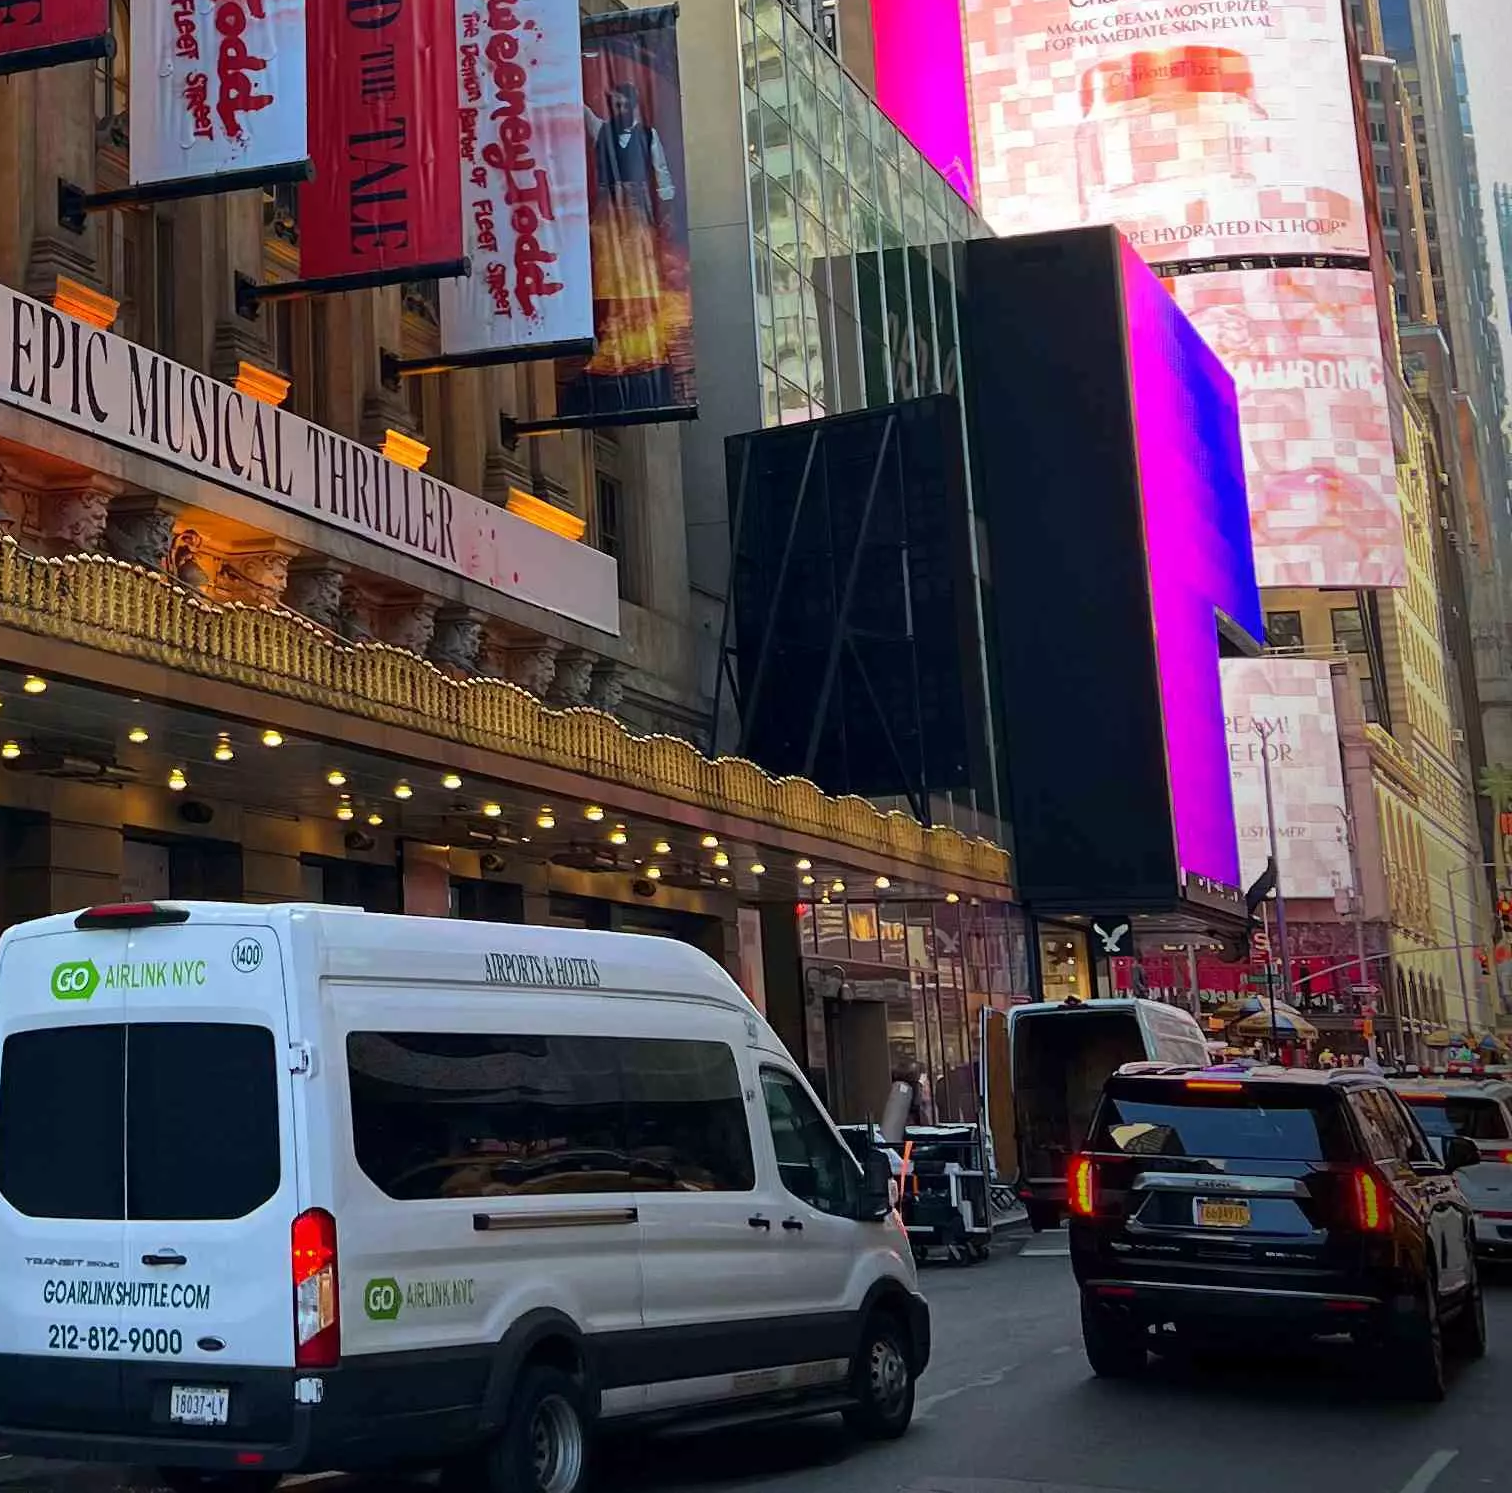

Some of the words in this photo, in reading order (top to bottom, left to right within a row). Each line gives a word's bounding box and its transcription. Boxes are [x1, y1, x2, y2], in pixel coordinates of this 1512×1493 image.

[1044, 37, 1077, 53] FOR
[1079, 24, 1167, 48] IMMEDIATE
[1172, 18, 1209, 37] SKIN
[1211, 15, 1274, 36] REVIVAL
[1047, 18, 1098, 37] MAGIC
[1102, 9, 1161, 29] CREAM
[1164, 0, 1270, 19] MOISTURIZER
[360, 46, 395, 105] THE
[347, 116, 409, 256] TALE
[505, 169, 564, 317] Todd
[1152, 221, 1251, 243] HYDRATED
[1255, 219, 1275, 235] IN
[1279, 219, 1287, 233] 1
[10, 297, 108, 423] EPIC
[128, 343, 294, 497] MUSICAL
[306, 425, 457, 563] THRILLER
[236, 945, 260, 966] 1400
[484, 953, 543, 985] AIRPORTS
[556, 957, 601, 988] HOTELS
[56, 968, 89, 992] GO
[105, 962, 167, 989] AIRLINK
[172, 960, 207, 986] NYC
[43, 1279, 210, 1310] GOAIRLINKSHUTTLE.COM
[369, 1285, 395, 1311] GO
[48, 1324, 182, 1355] 212-812-9000
